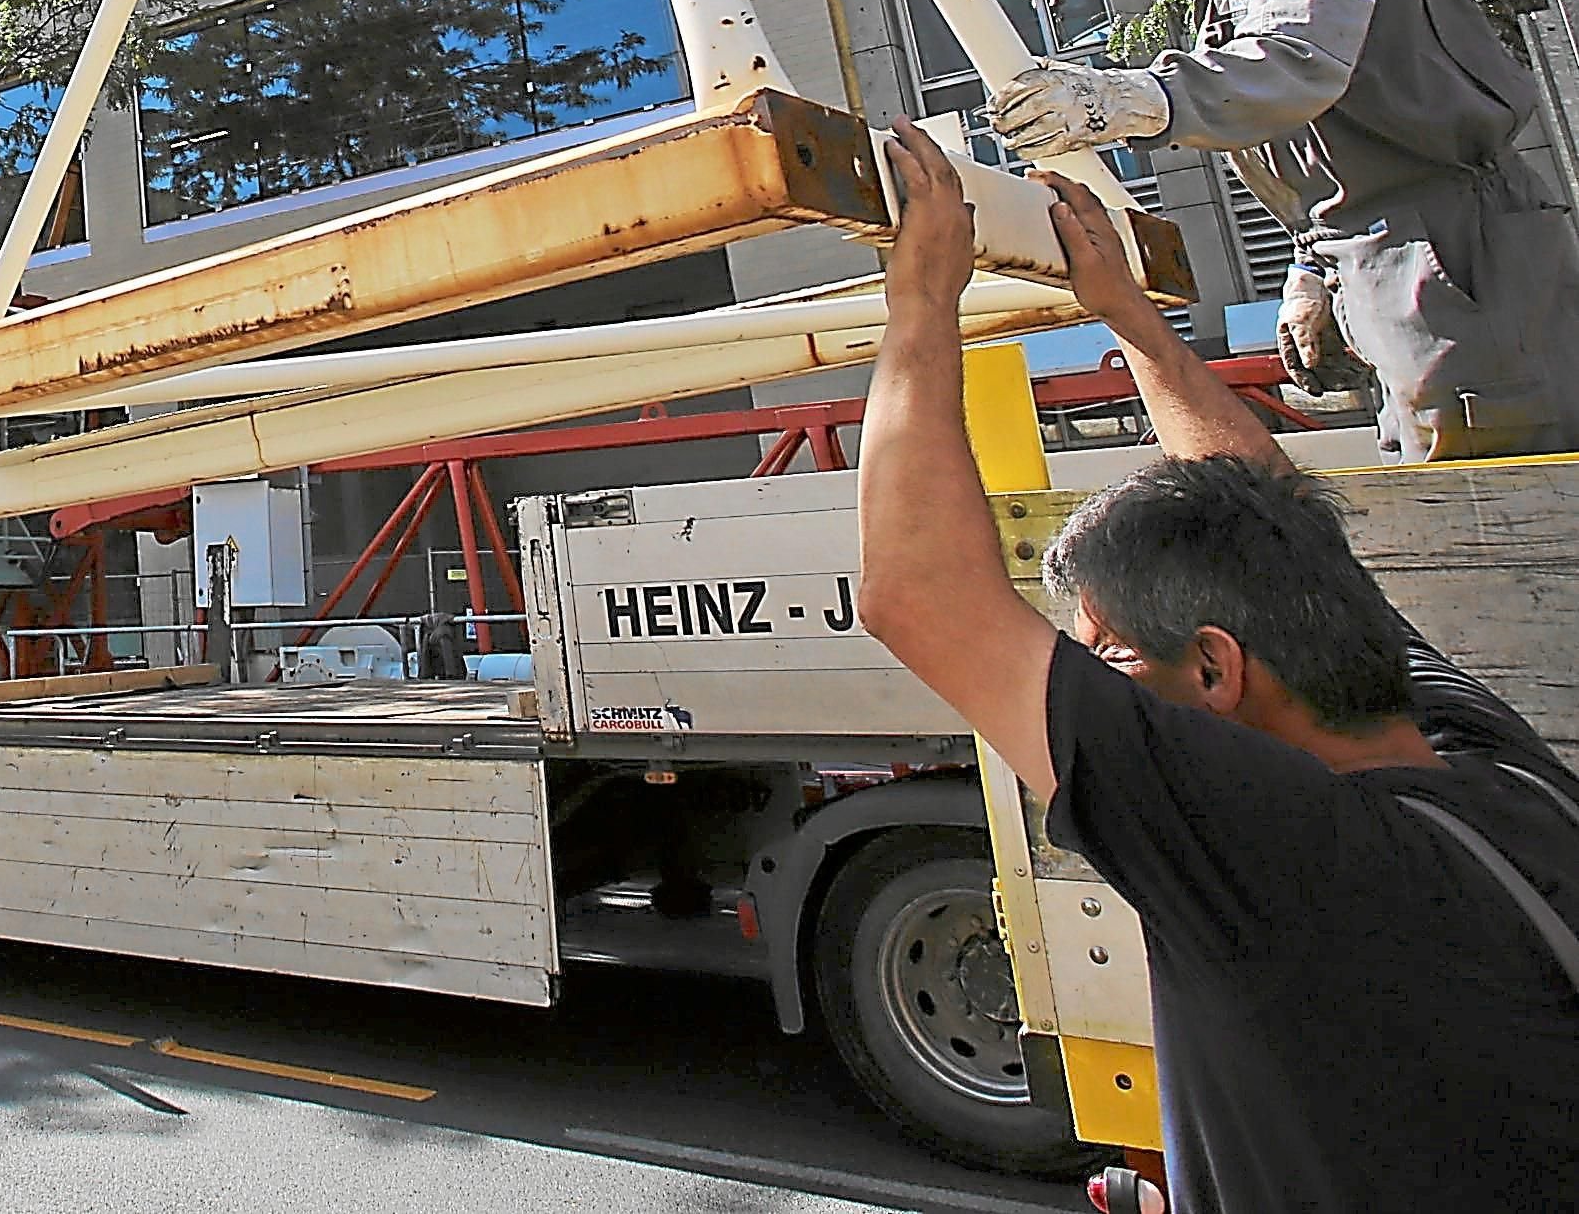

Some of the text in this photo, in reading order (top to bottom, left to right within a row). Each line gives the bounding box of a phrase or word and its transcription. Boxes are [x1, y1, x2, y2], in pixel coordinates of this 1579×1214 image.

[604, 581, 773, 638] HEINZ
[823, 576, 854, 632] J
[591, 707, 664, 720] SCHMITZ
[592, 720, 664, 730] CARGOBULL
